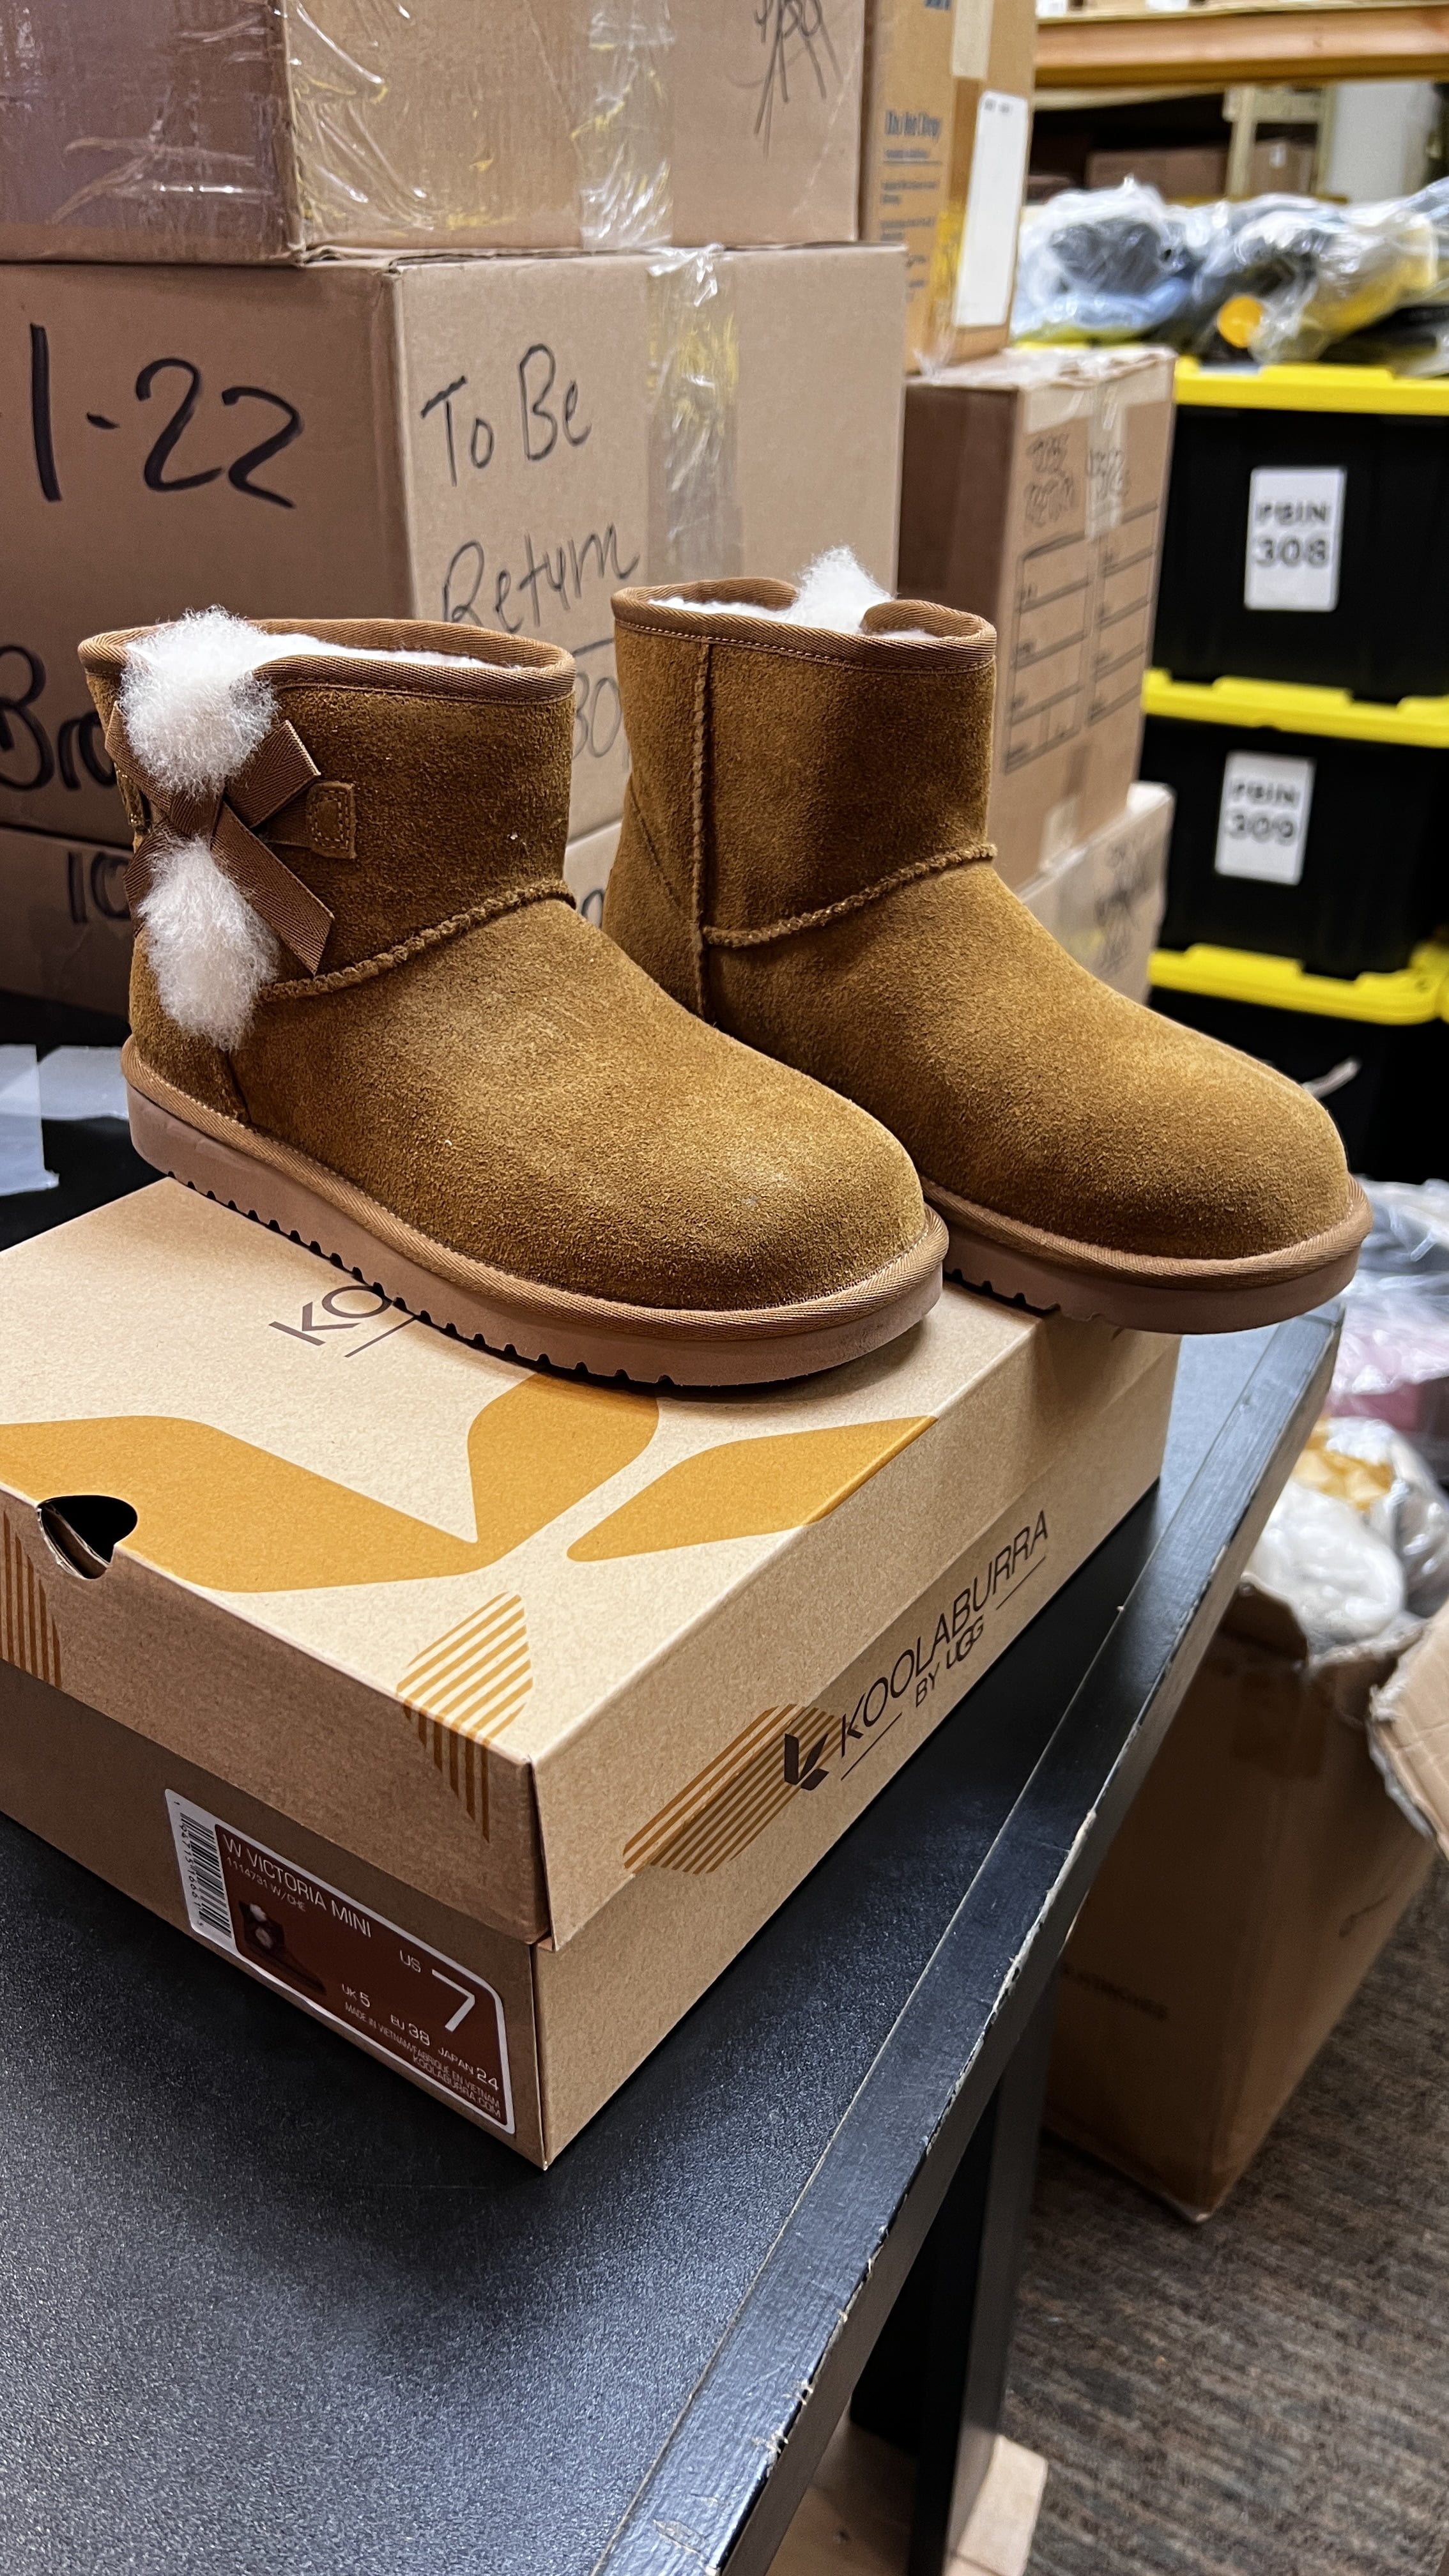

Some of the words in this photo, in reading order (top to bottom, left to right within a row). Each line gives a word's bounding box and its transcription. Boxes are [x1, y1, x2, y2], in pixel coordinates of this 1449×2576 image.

[30, 322, 305, 509] 1-22
[420, 375, 495, 487] To
[518, 342, 592, 461] Be
[442, 523, 641, 634] Return
[841, 1510, 1048, 1758] KOOLABURRA
[916, 1662, 940, 1708] BY
[946, 1614, 985, 1669] UGG
[223, 1834, 241, 1858] W
[247, 1848, 327, 1911] VICTORIA
[331, 1899, 372, 1938] MINI
[342, 1982, 358, 2002] UK
[359, 1991, 371, 2007] 5
[390, 2014, 405, 2031] EU
[408, 2023, 430, 2046] 38
[400, 1949, 422, 1973] US
[432, 1968, 475, 2032] 7
[438, 2046, 474, 2076] JAPAN
[476, 2066, 499, 2091] 24
